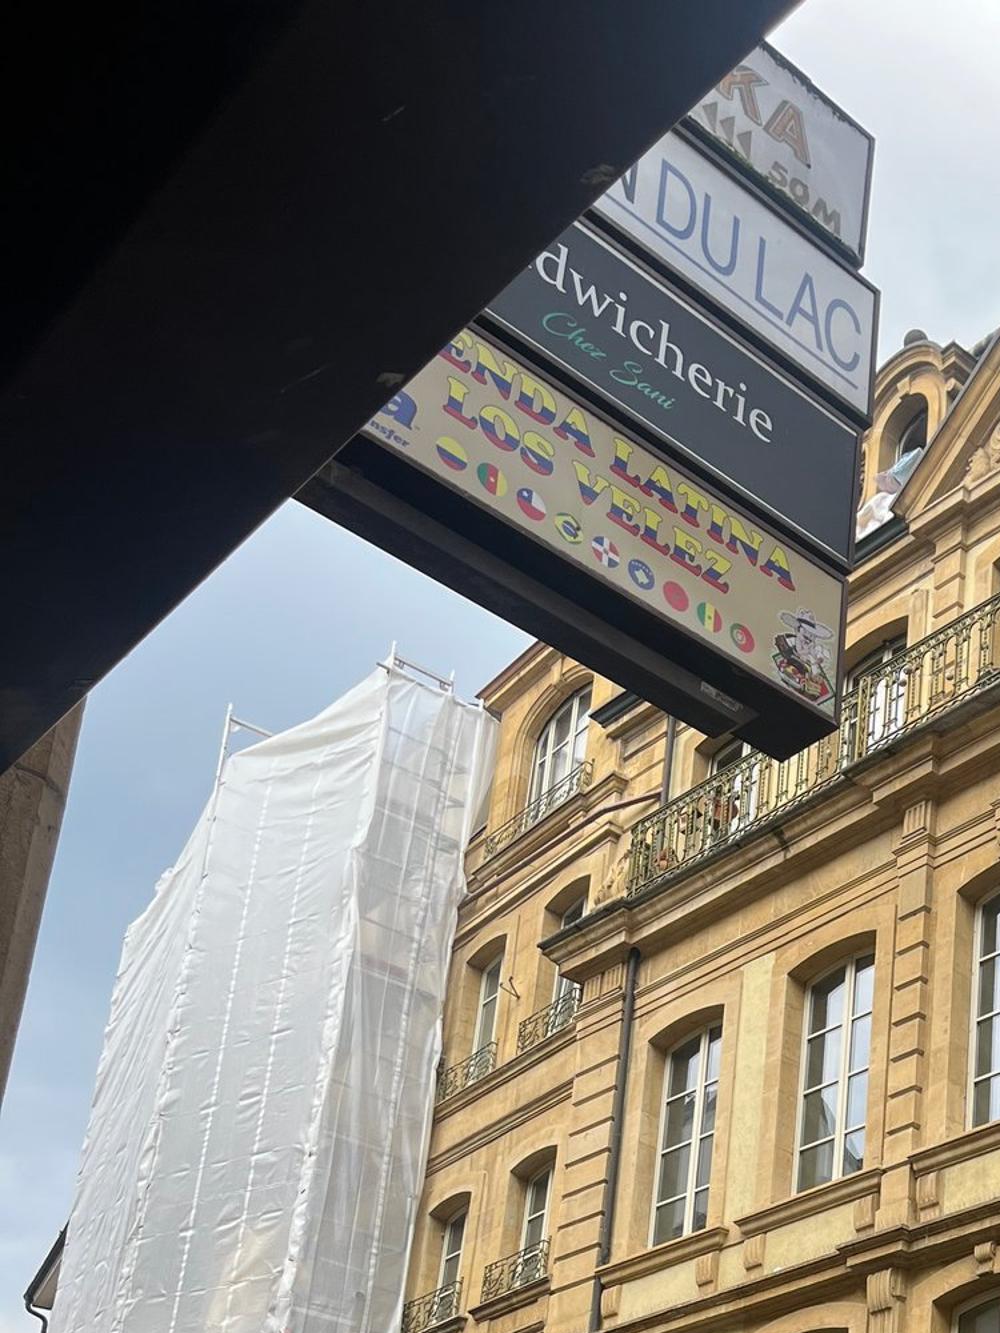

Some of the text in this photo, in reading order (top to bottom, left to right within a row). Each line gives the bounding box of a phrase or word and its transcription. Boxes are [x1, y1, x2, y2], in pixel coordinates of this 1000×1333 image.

[533, 243, 773, 443] dwicherie
[542, 312, 676, 409] Chez Sani
[655, 158, 740, 277] DU
[754, 236, 862, 372] LAC
[442, 376, 732, 594] LOS VELEZ
[609, 436, 796, 592] LATINA
